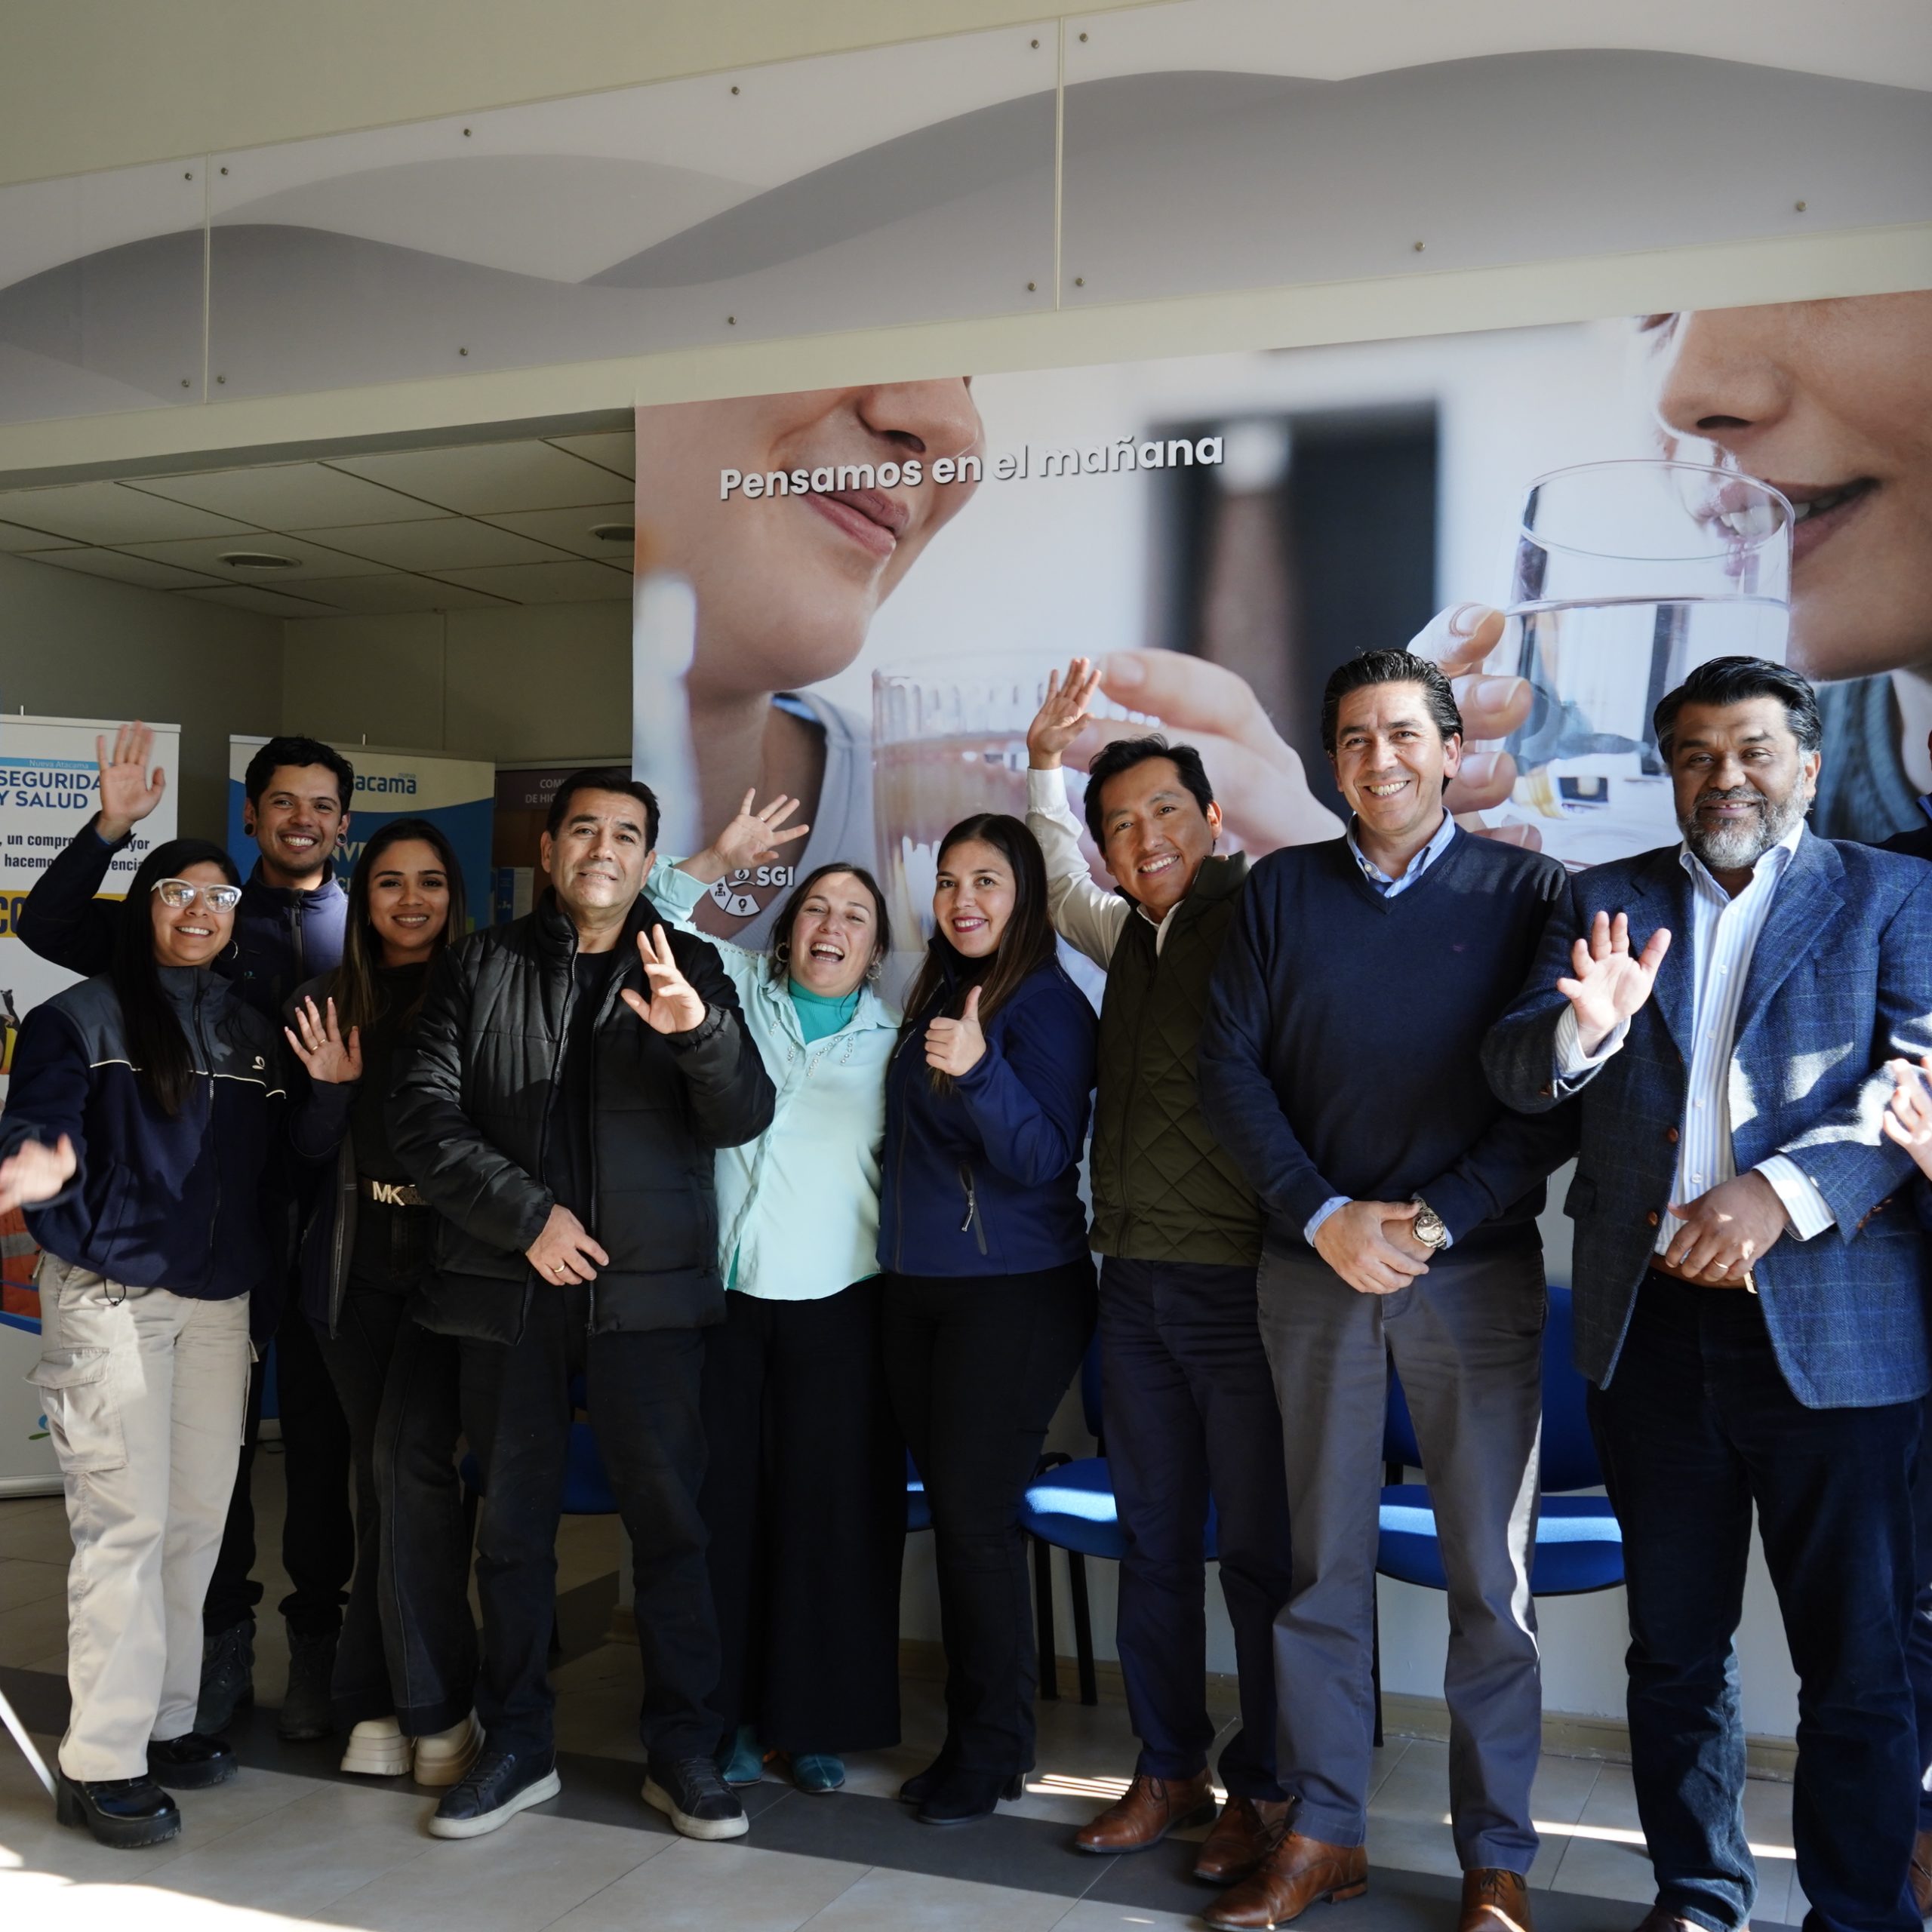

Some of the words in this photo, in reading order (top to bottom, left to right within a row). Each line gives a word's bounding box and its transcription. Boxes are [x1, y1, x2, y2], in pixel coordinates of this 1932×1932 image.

[721, 460, 923, 500] Pensamos
[932, 456, 983, 484] en
[992, 445, 1028, 481] el
[1039, 435, 1223, 477] mañana
[29, 759, 54, 768] Nueva
[55, 761, 89, 769] Atacama
[0, 770, 101, 790] SEGURIDA
[353, 775, 417, 794] acama
[0, 790, 9, 806] Y
[15, 791, 88, 809] SALUD
[8, 835, 23, 845] un
[27, 835, 75, 850] compro
[5, 854, 54, 868] hacemo
[756, 866, 795, 887] SGI
[372, 1181, 405, 1206] MK
